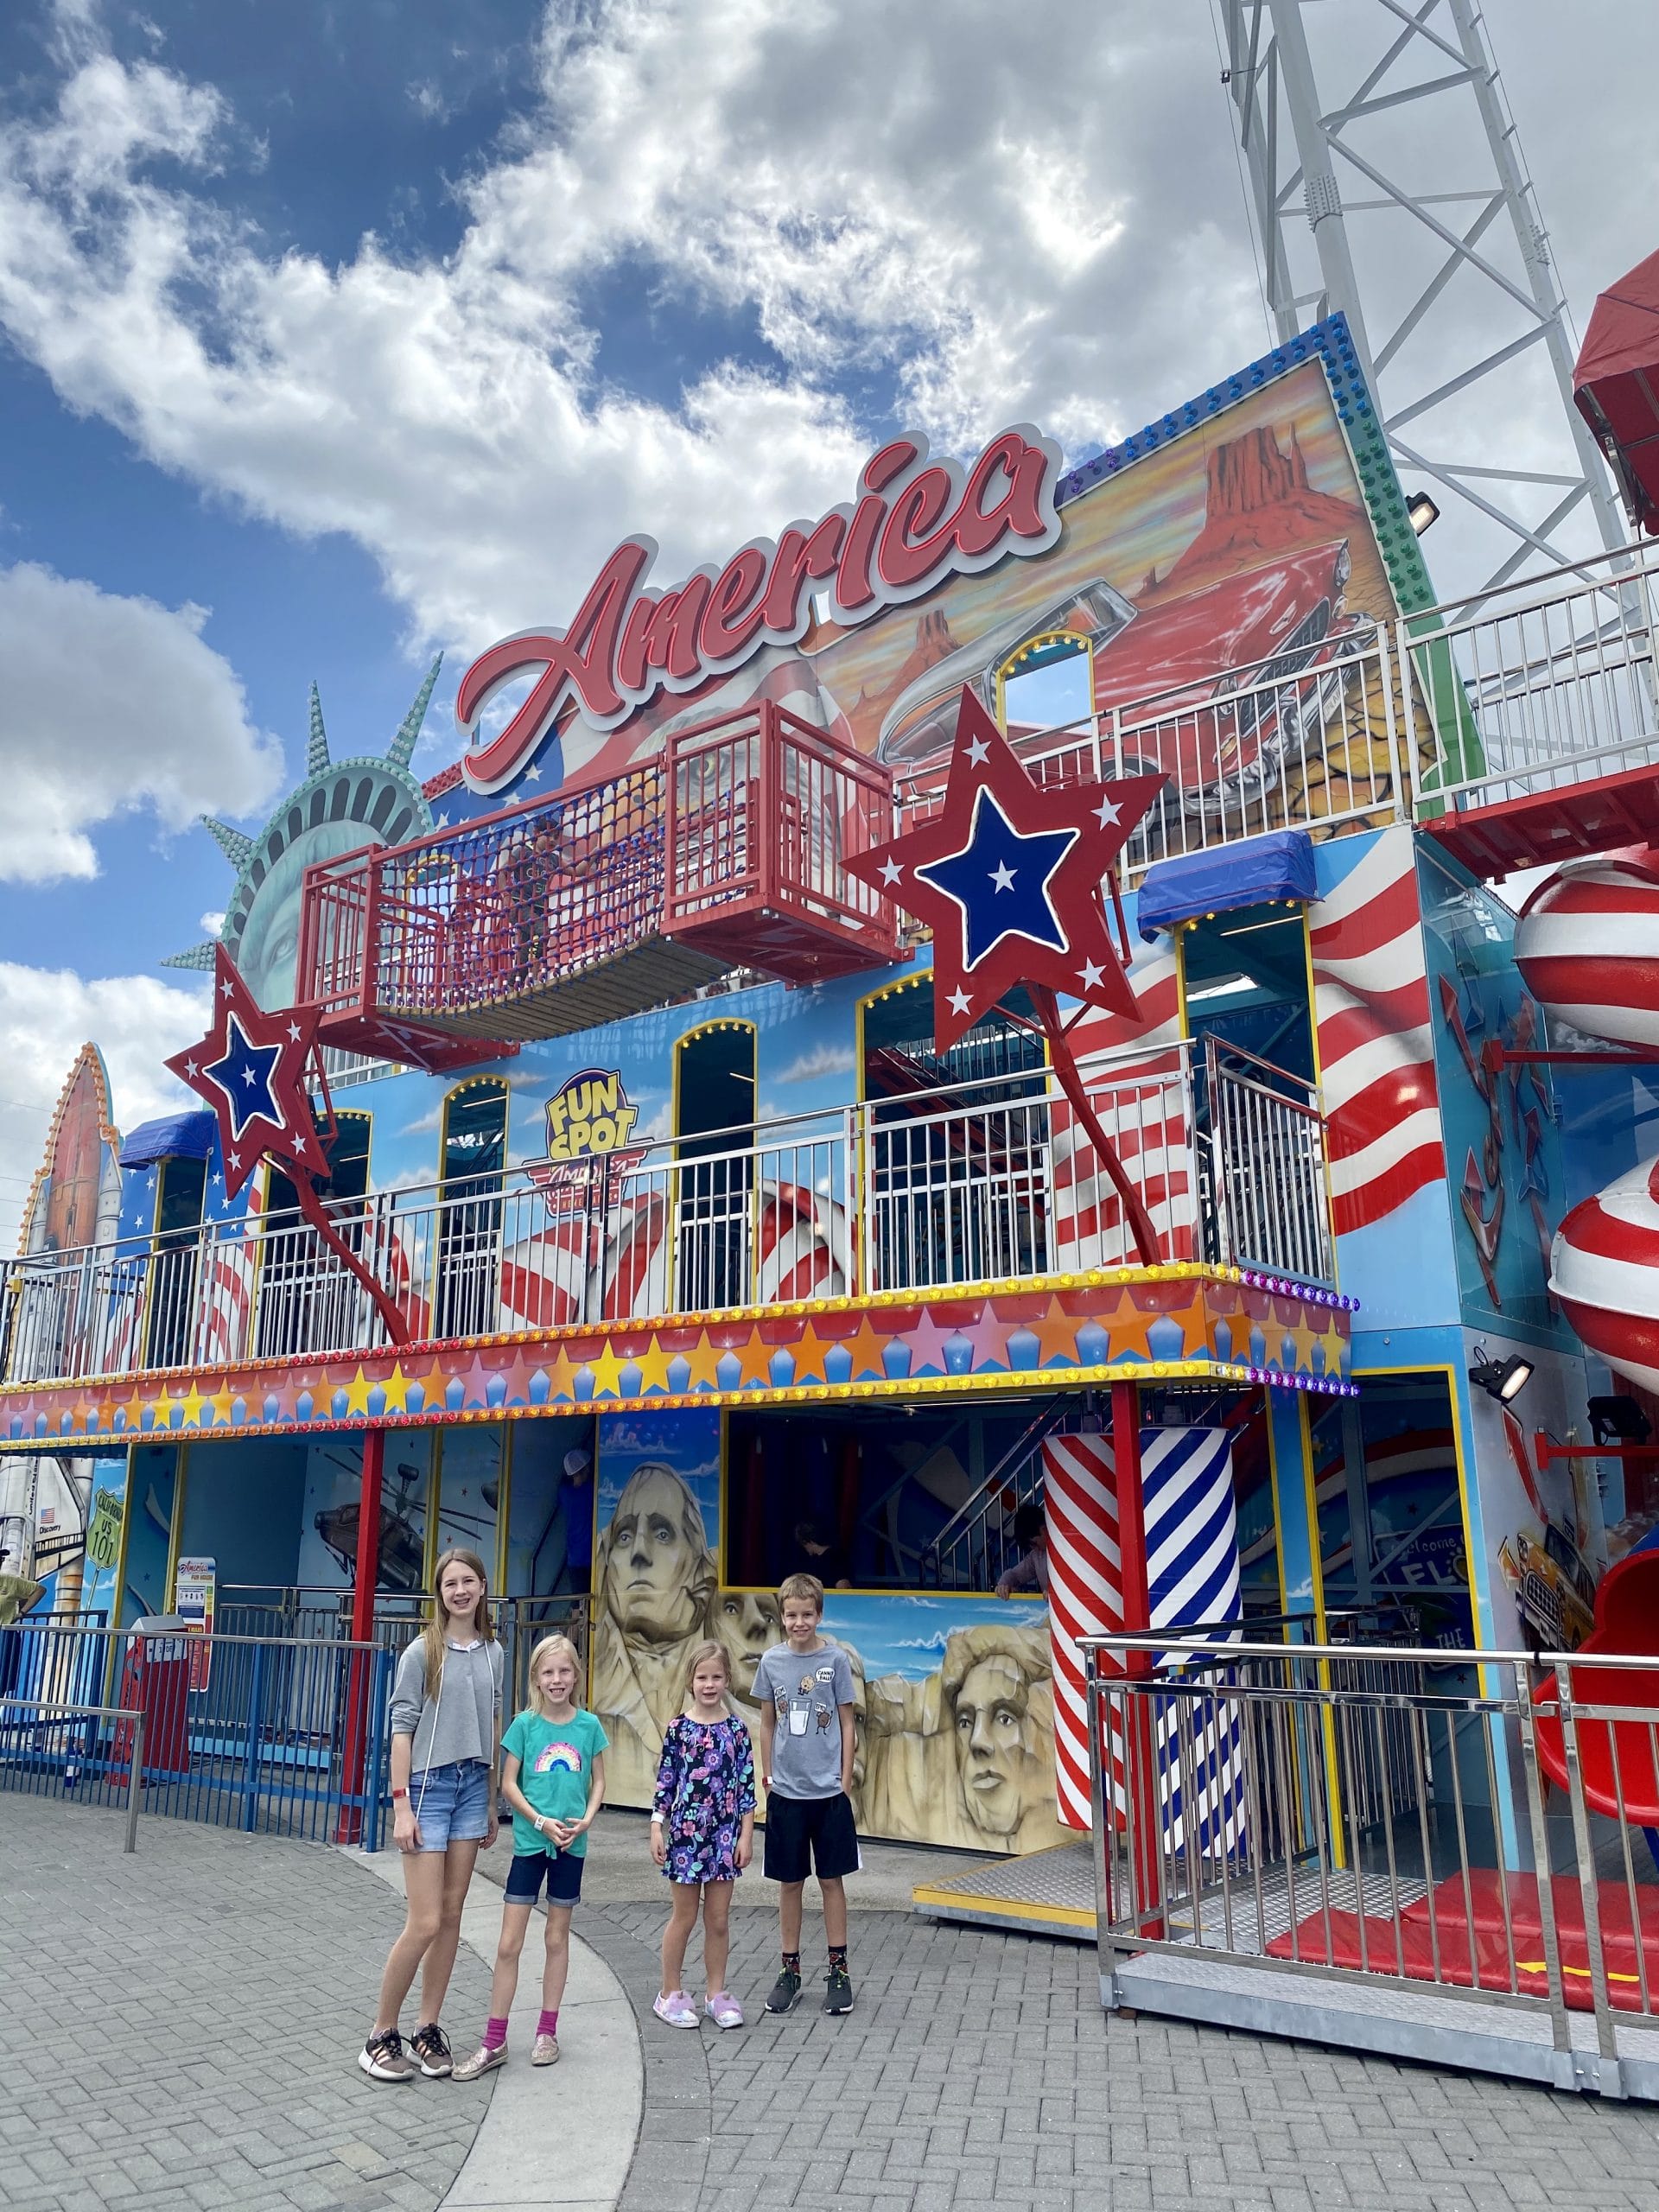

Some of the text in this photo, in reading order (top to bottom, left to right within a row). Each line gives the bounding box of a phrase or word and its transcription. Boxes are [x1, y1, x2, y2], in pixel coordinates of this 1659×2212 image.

[457, 433, 1047, 784] America
[548, 1073, 619, 1135] FUN
[549, 1109, 635, 1160] SPOT
[98, 1495, 124, 1522] CALIFORNI
[101, 1519, 112, 1535] US
[92, 1530, 114, 1564] 101
[1435, 1628, 1466, 1649] THE
